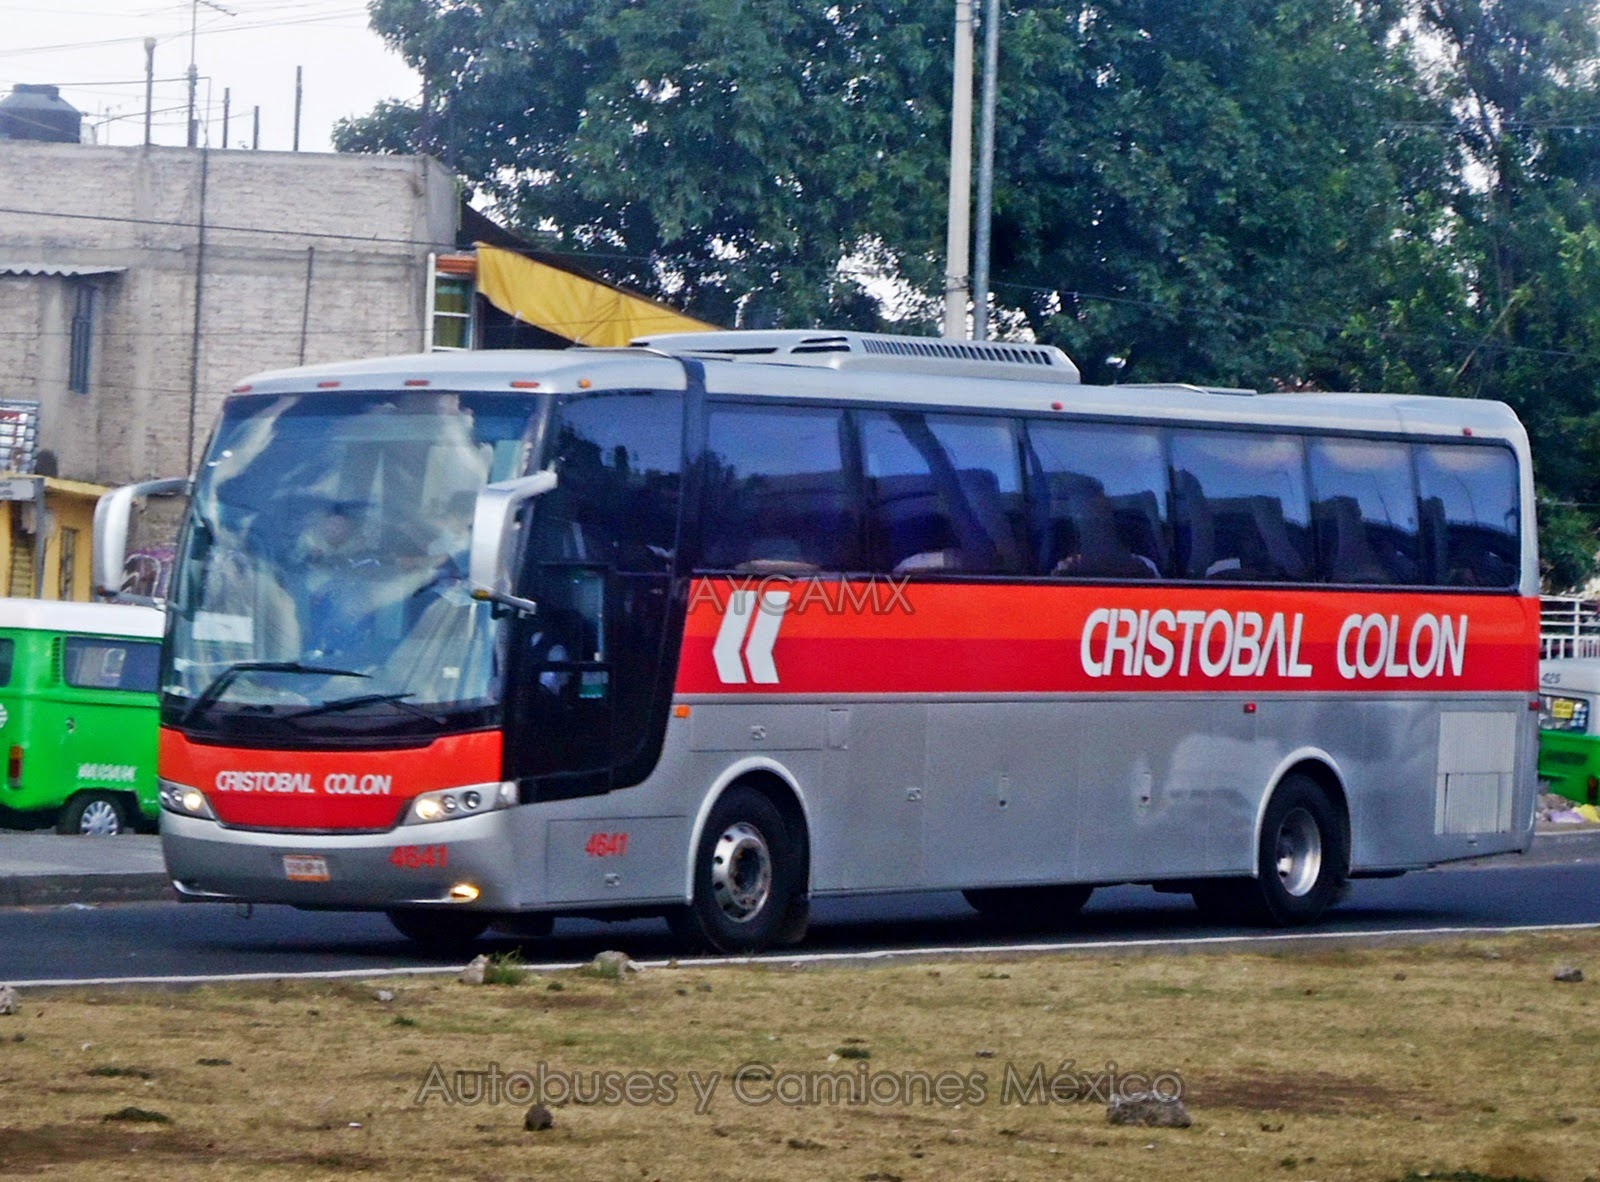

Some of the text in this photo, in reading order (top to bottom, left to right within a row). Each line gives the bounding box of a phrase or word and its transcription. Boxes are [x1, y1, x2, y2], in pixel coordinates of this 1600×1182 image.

[1080, 608, 1468, 679] CRISTOBAL COLON
[215, 771, 392, 795] CRISTOBAL COLON
[585, 833, 628, 856] 4641
[390, 845, 448, 868] 4641
